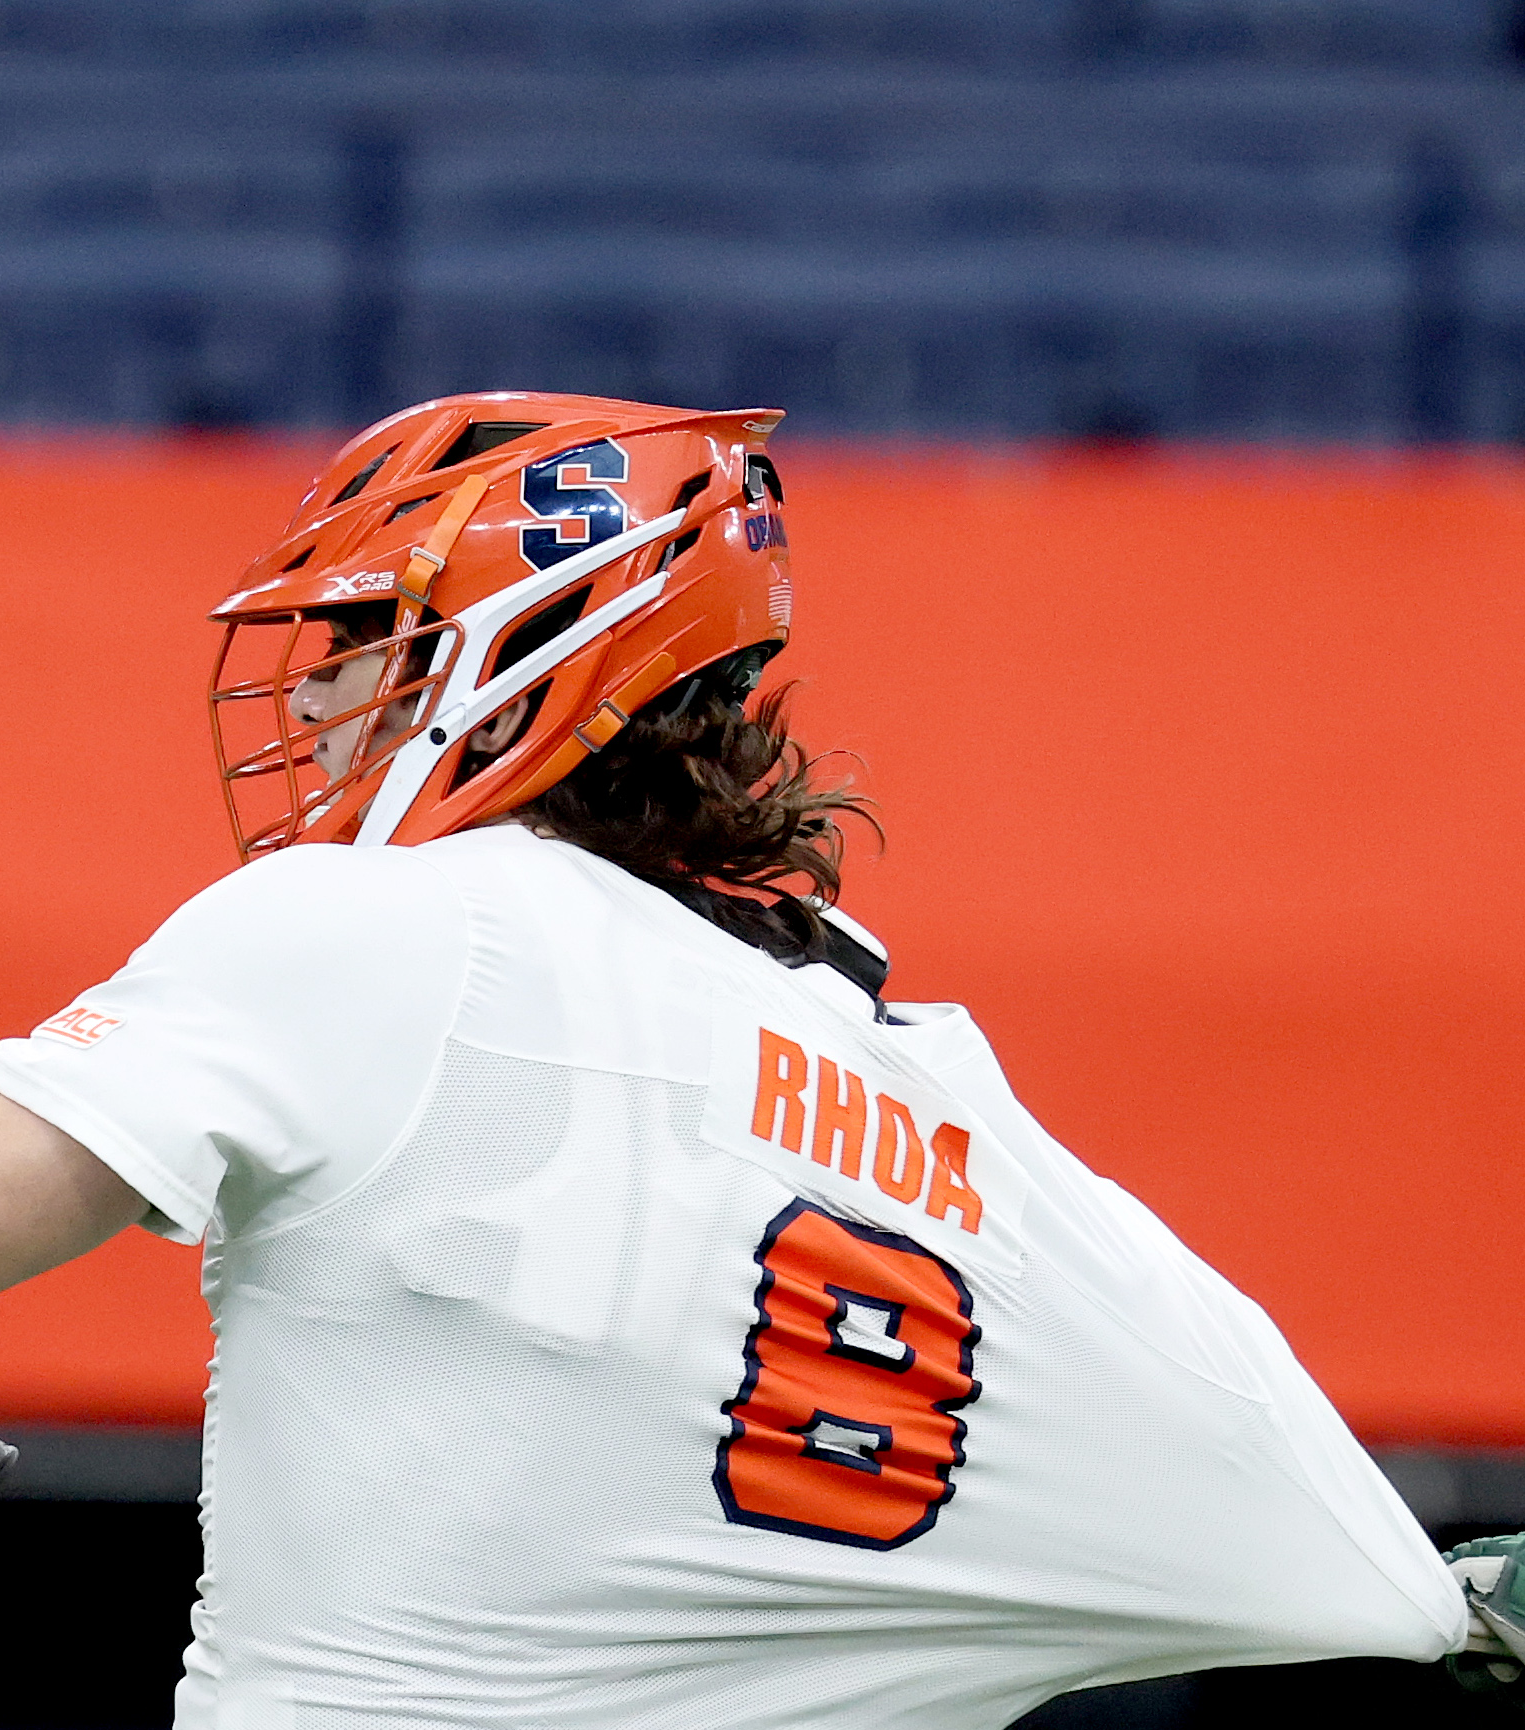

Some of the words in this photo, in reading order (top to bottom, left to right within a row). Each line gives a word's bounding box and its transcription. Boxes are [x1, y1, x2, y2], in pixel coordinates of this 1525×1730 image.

[518, 437, 629, 572] S
[48, 1007, 121, 1039] ACC
[750, 1026, 982, 1234] RHOA
[712, 1196, 983, 1551] 8
